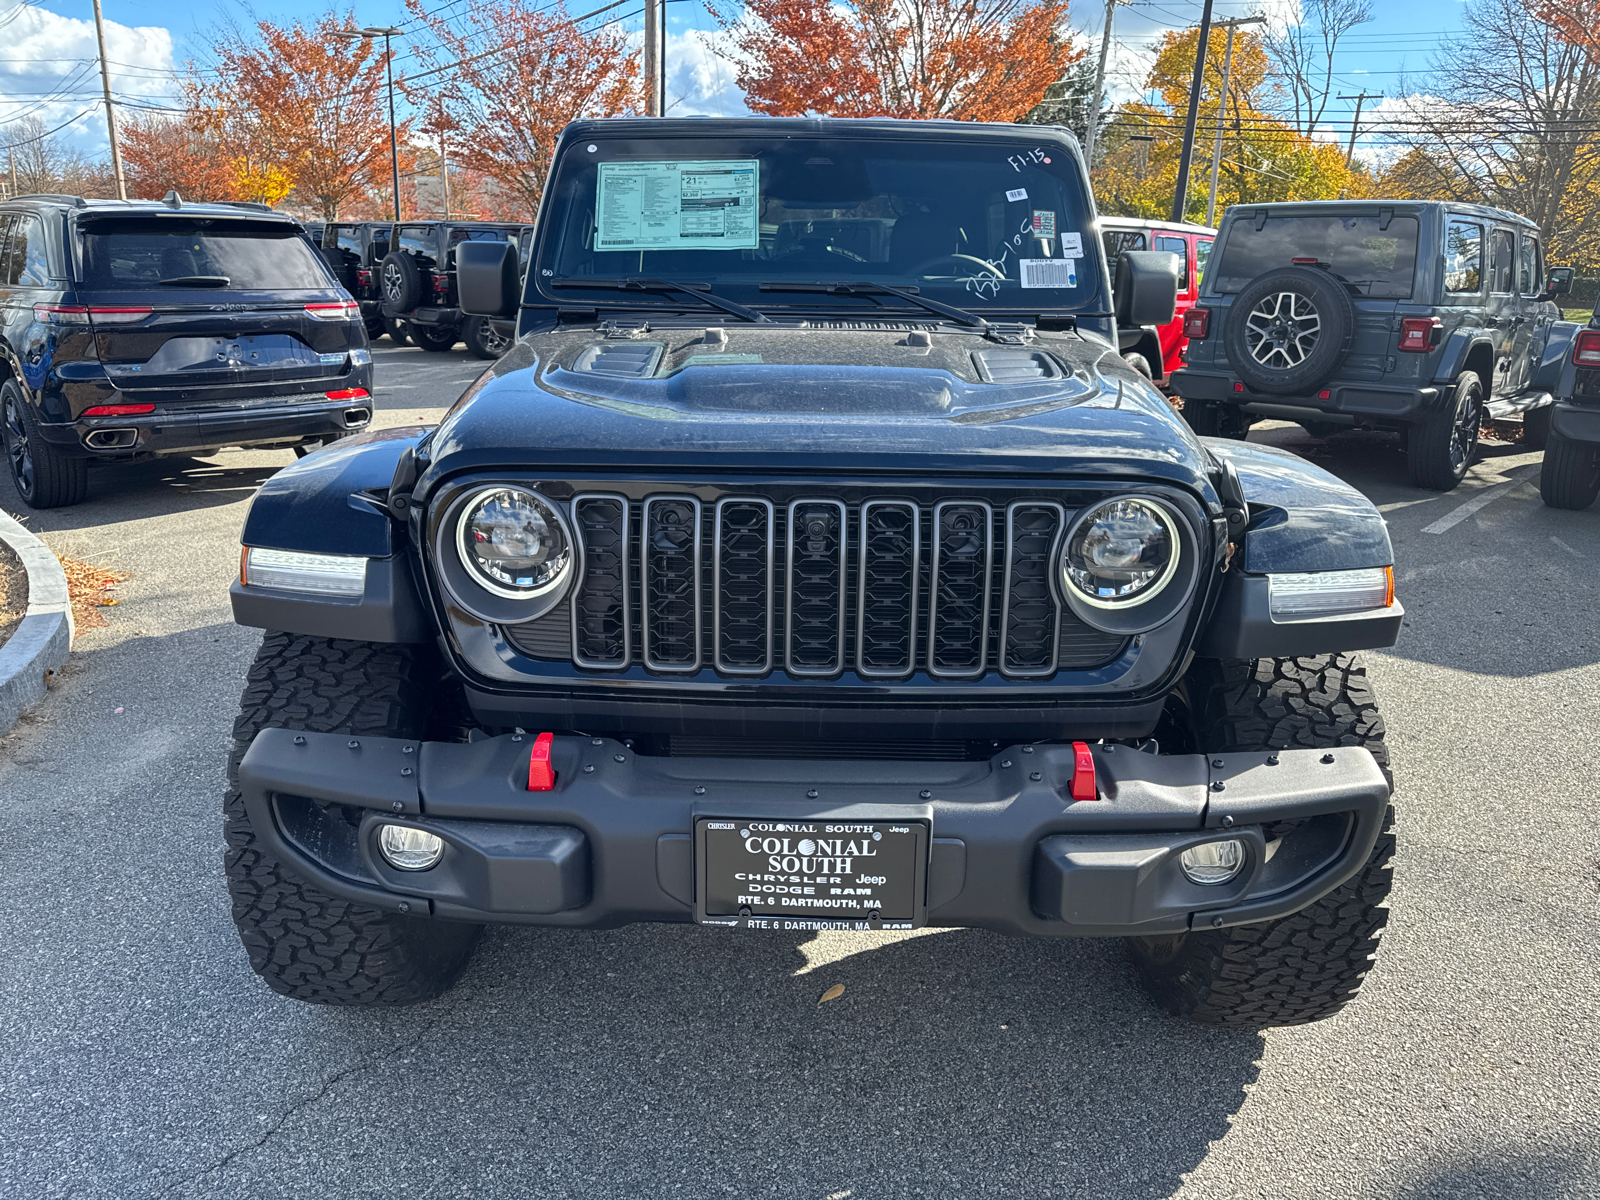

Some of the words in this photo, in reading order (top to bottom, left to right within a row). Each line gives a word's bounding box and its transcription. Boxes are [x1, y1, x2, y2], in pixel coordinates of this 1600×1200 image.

[707, 822, 736, 830] CHRYSLER
[748, 823, 818, 834] COLONIAL
[825, 824, 874, 834] SOUTH
[889, 825, 910, 834] Jeep
[744, 836, 878, 857] COLONIAL
[768, 855, 854, 874] SOUTH
[734, 872, 842, 884] CHRYSLER
[855, 874, 887, 887] Jeep
[748, 883, 816, 895] DODGE
[830, 887, 872, 896] RAM
[737, 895, 765, 905] RTE.
[767, 896, 775, 906] 6
[781, 897, 861, 909] DARTMOUTH,
[863, 899, 882, 909] MA
[747, 919, 771, 929] RTE.
[773, 920, 779, 930] 6
[855, 921, 871, 931] MA
